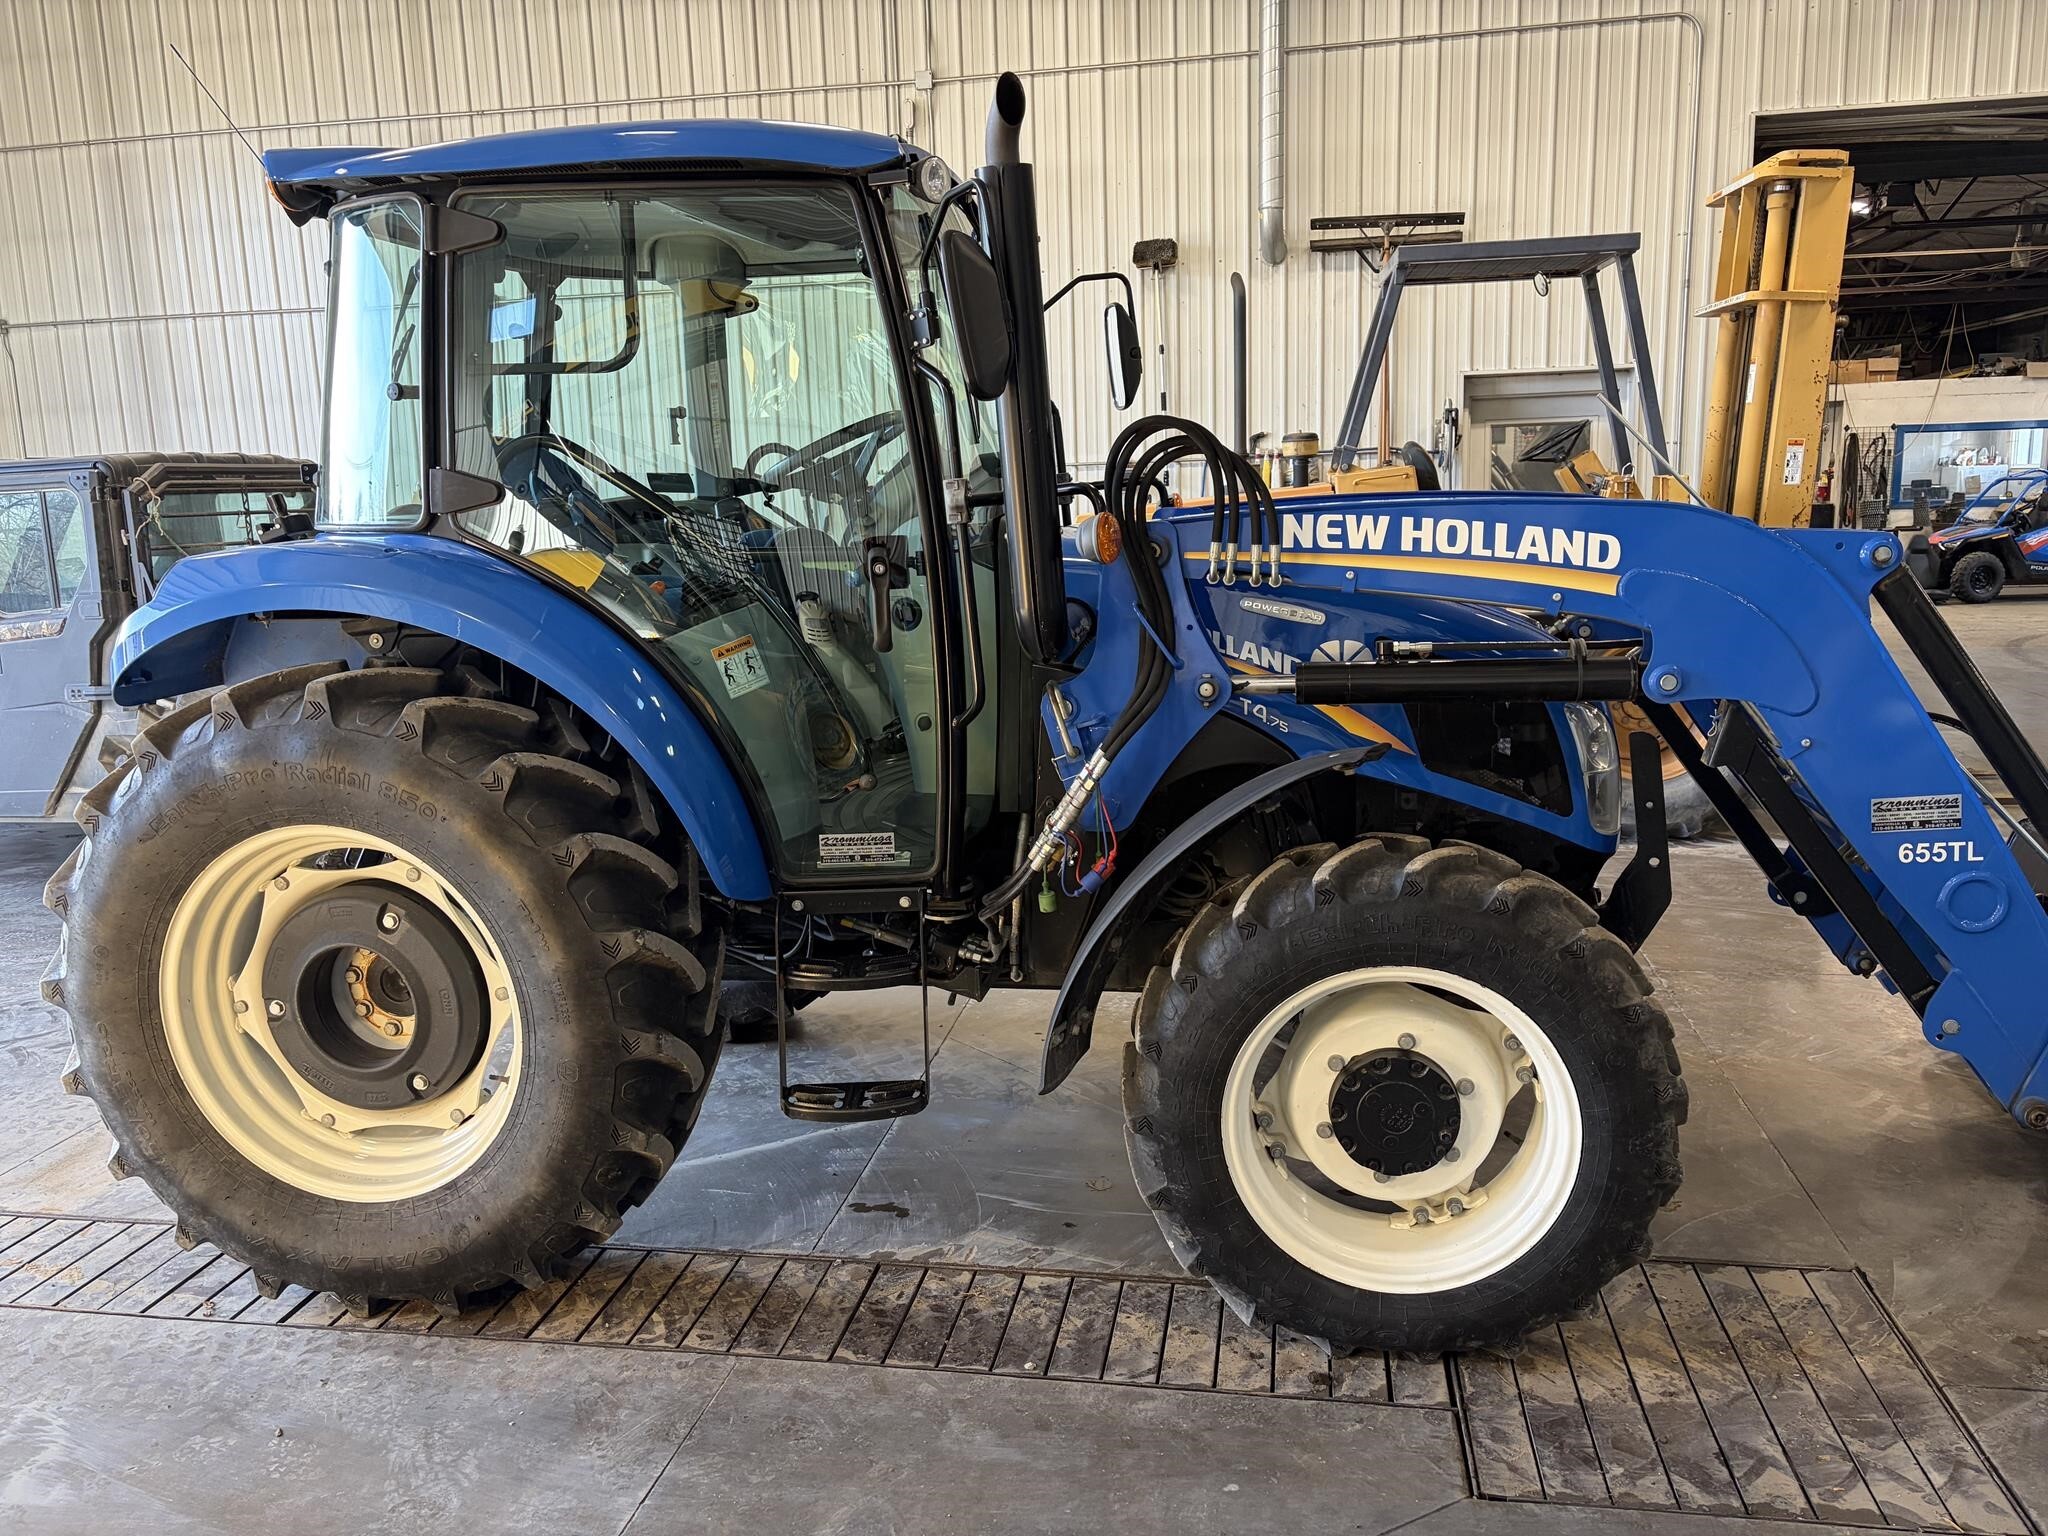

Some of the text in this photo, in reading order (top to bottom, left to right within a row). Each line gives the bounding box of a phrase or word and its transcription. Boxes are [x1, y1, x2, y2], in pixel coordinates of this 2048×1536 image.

[1282, 514, 1622, 570] NEW HOLLAND
[1239, 697, 1289, 733] T4.75
[284, 761, 371, 793] Radial
[378, 780, 438, 822] 850
[1872, 796, 1960, 813] Kromminga
[820, 835, 893, 847] Kromminga
[1898, 841, 1984, 864] 655TL
